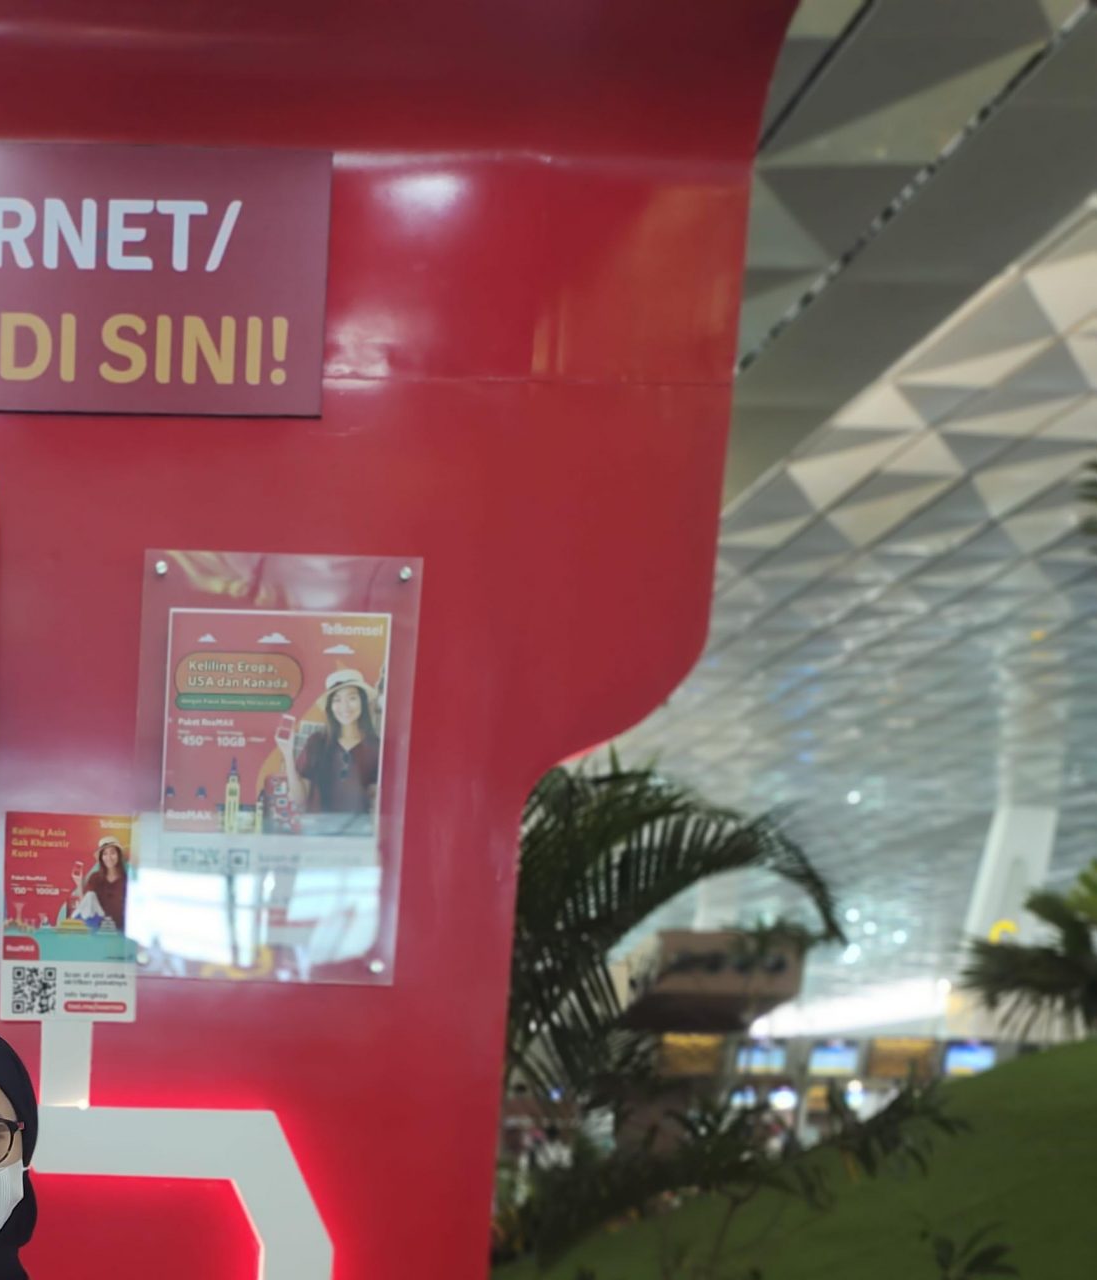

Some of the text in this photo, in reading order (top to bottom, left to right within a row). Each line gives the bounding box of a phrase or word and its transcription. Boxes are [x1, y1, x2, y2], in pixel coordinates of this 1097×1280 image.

[0, 311, 76, 381] DI
[98, 314, 290, 387] SINI!
[321, 622, 384, 637] Telkomsel
[189, 660, 277, 674] Keliling Eropa,
[188, 676, 288, 689] USA dan Kanada
